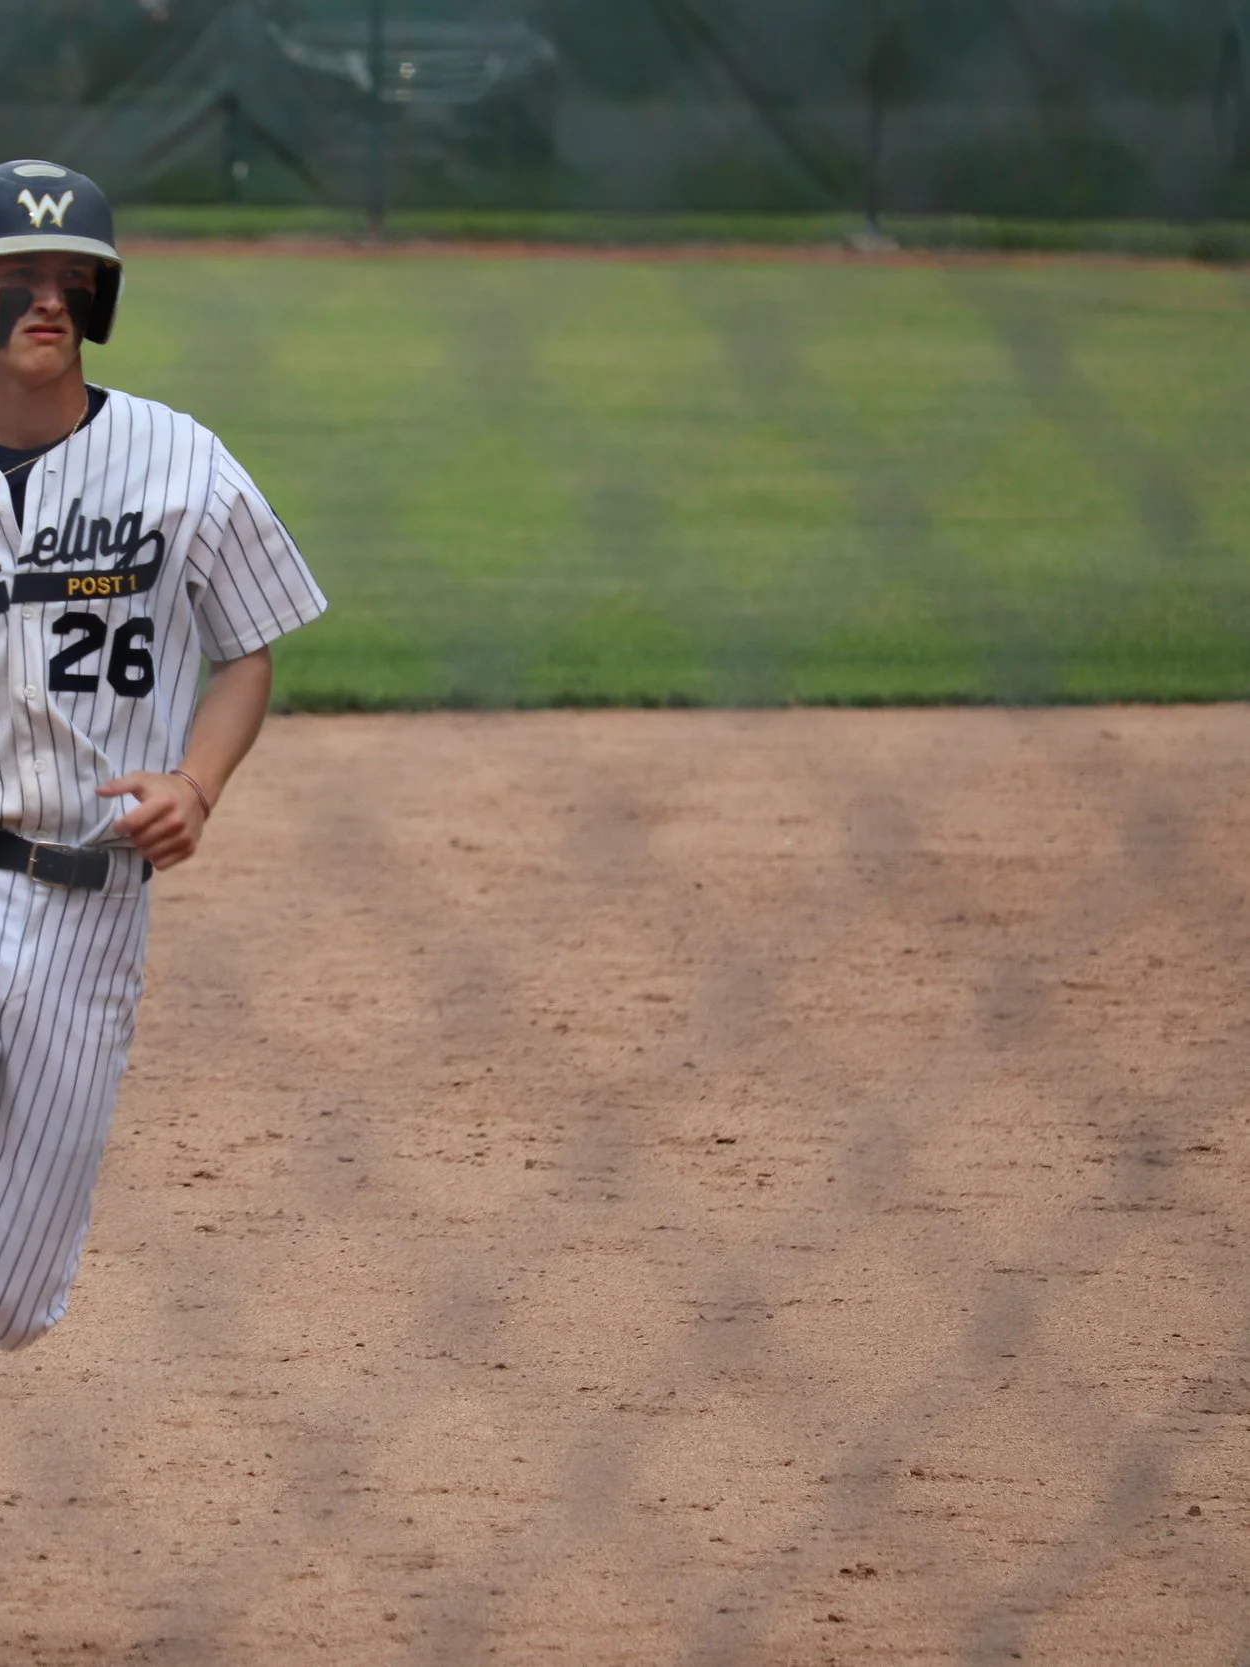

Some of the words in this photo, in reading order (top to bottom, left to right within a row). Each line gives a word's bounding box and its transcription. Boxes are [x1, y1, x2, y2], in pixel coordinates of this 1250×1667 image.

[17, 188, 74, 228] W
[67, 575, 124, 596] POST
[128, 574, 138, 591] 1
[49, 611, 155, 698] 26
